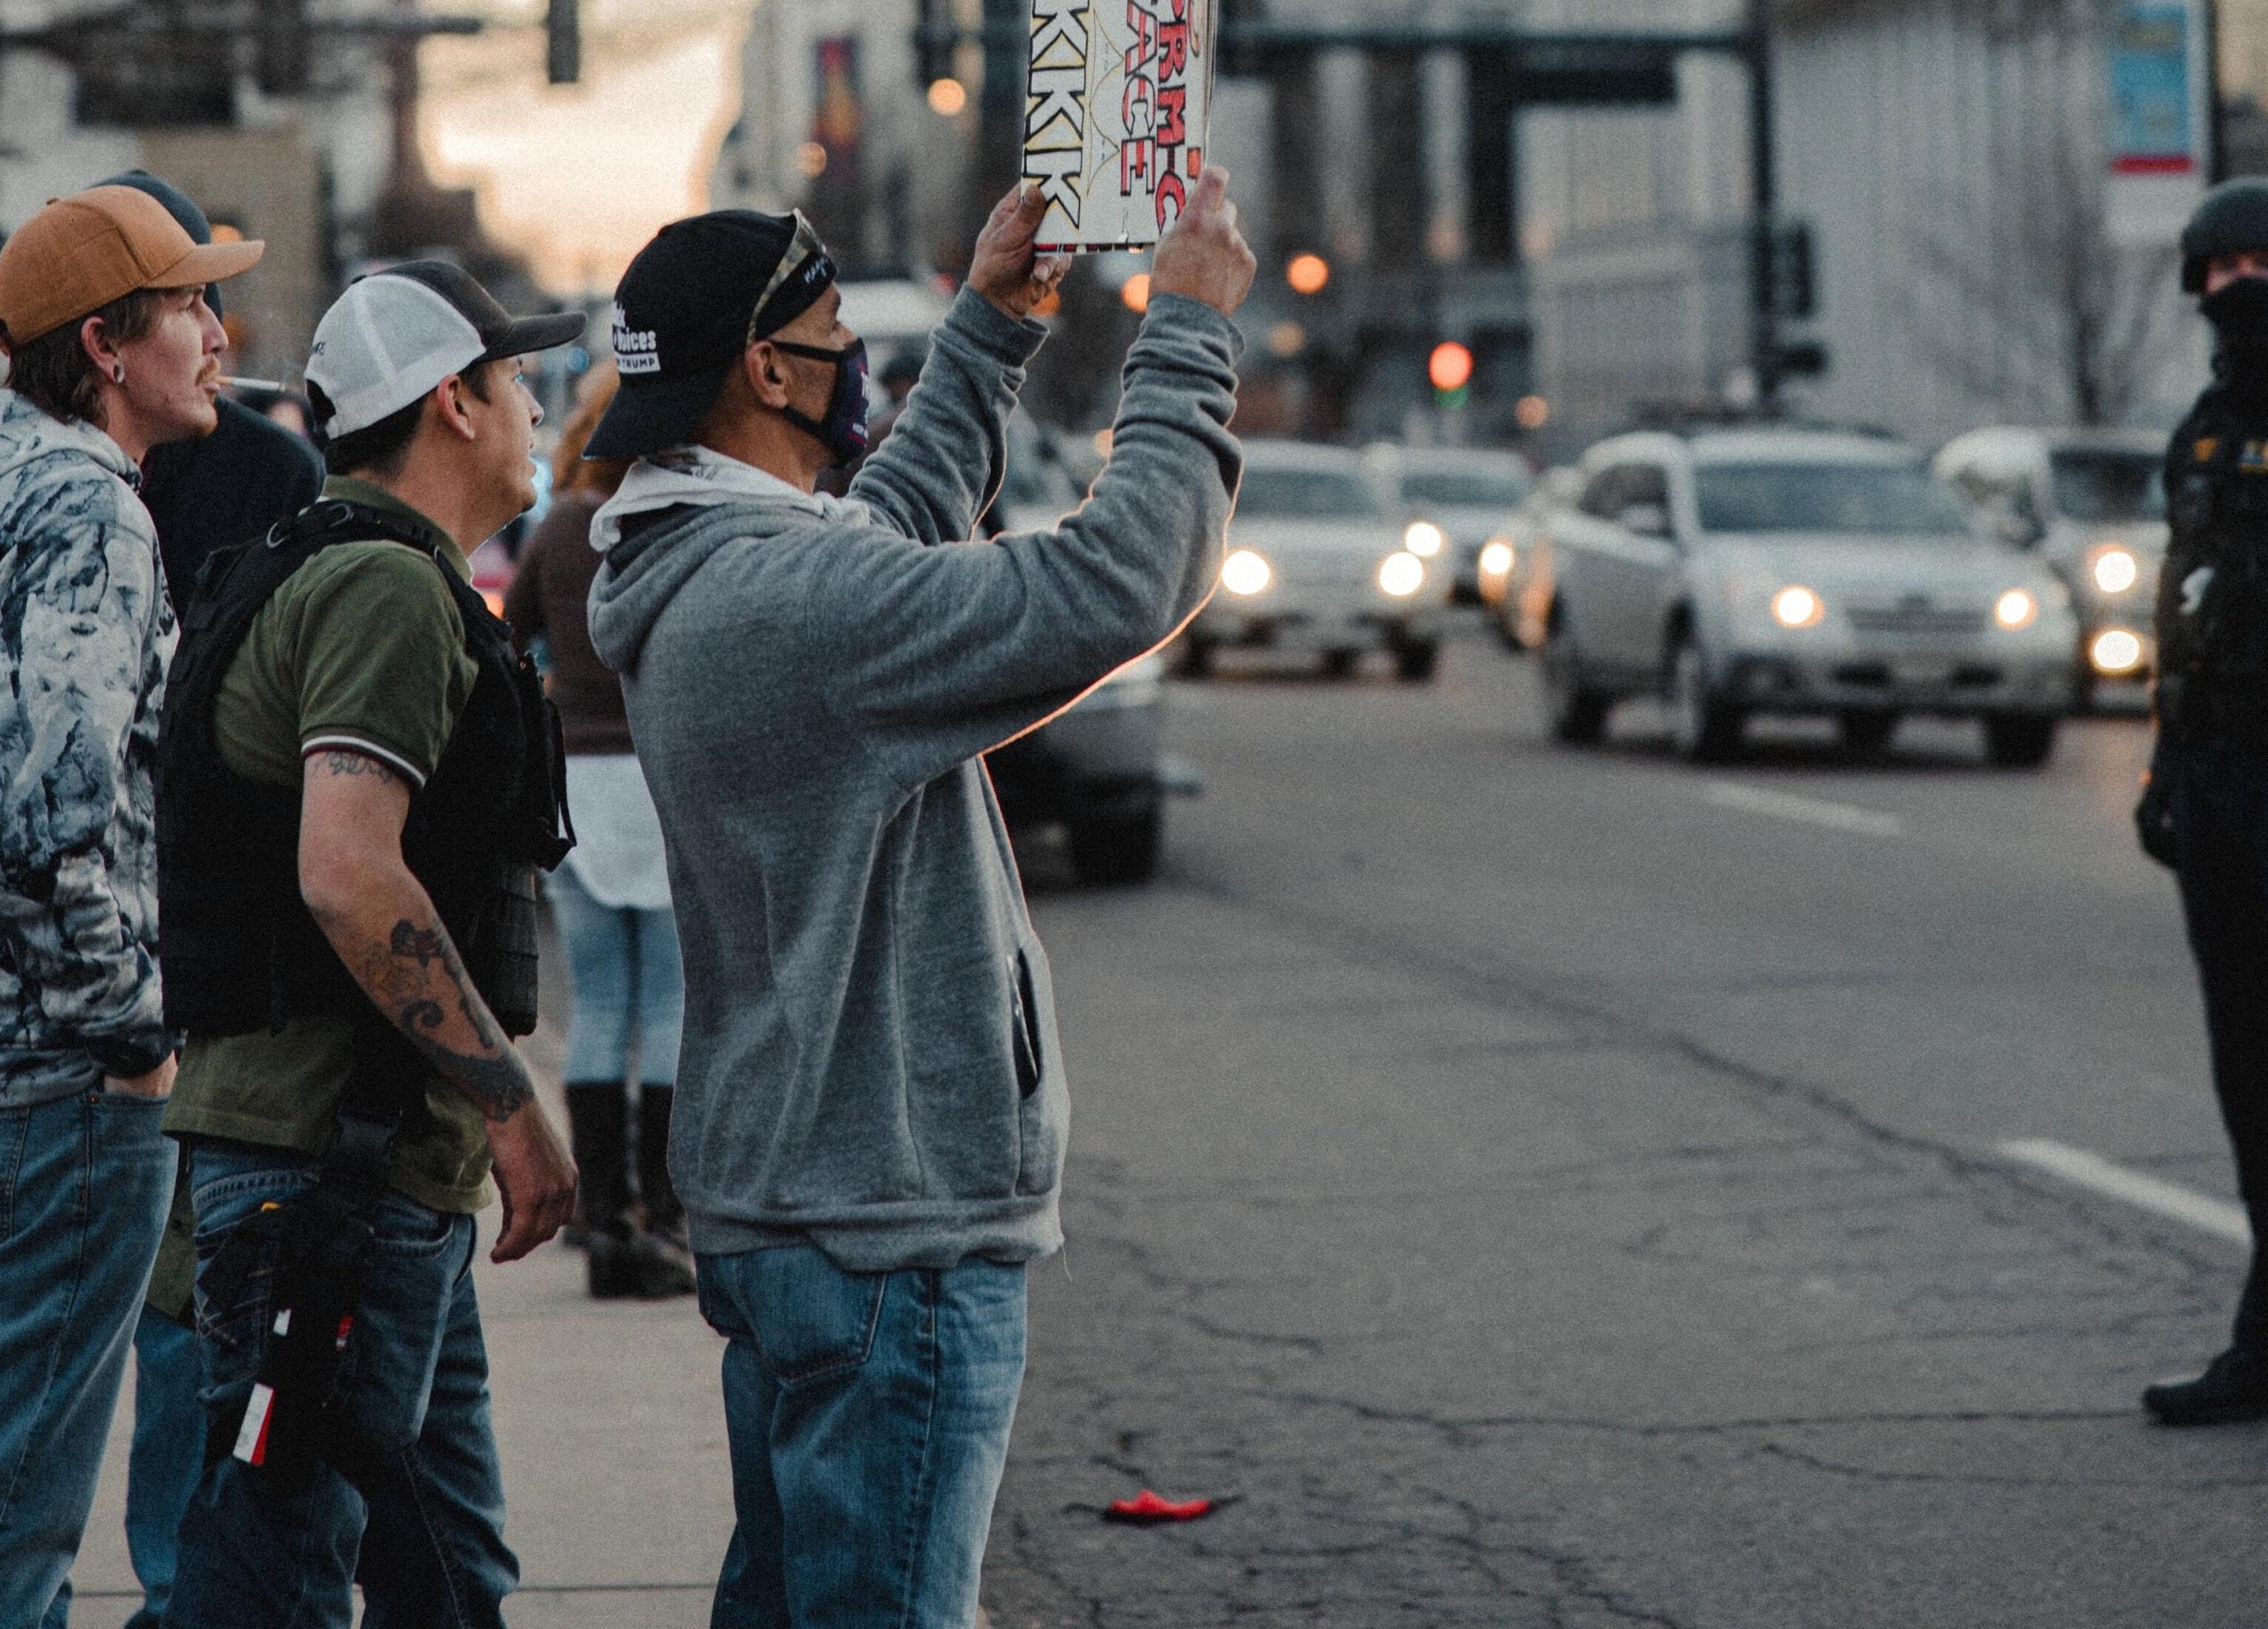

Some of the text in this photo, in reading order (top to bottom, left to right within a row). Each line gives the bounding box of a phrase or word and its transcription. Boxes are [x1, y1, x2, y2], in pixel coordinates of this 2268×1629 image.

[1021, 0, 1089, 229] KKK
[1121, 0, 1158, 196] ACE
[622, 357, 655, 368] TRUMP
